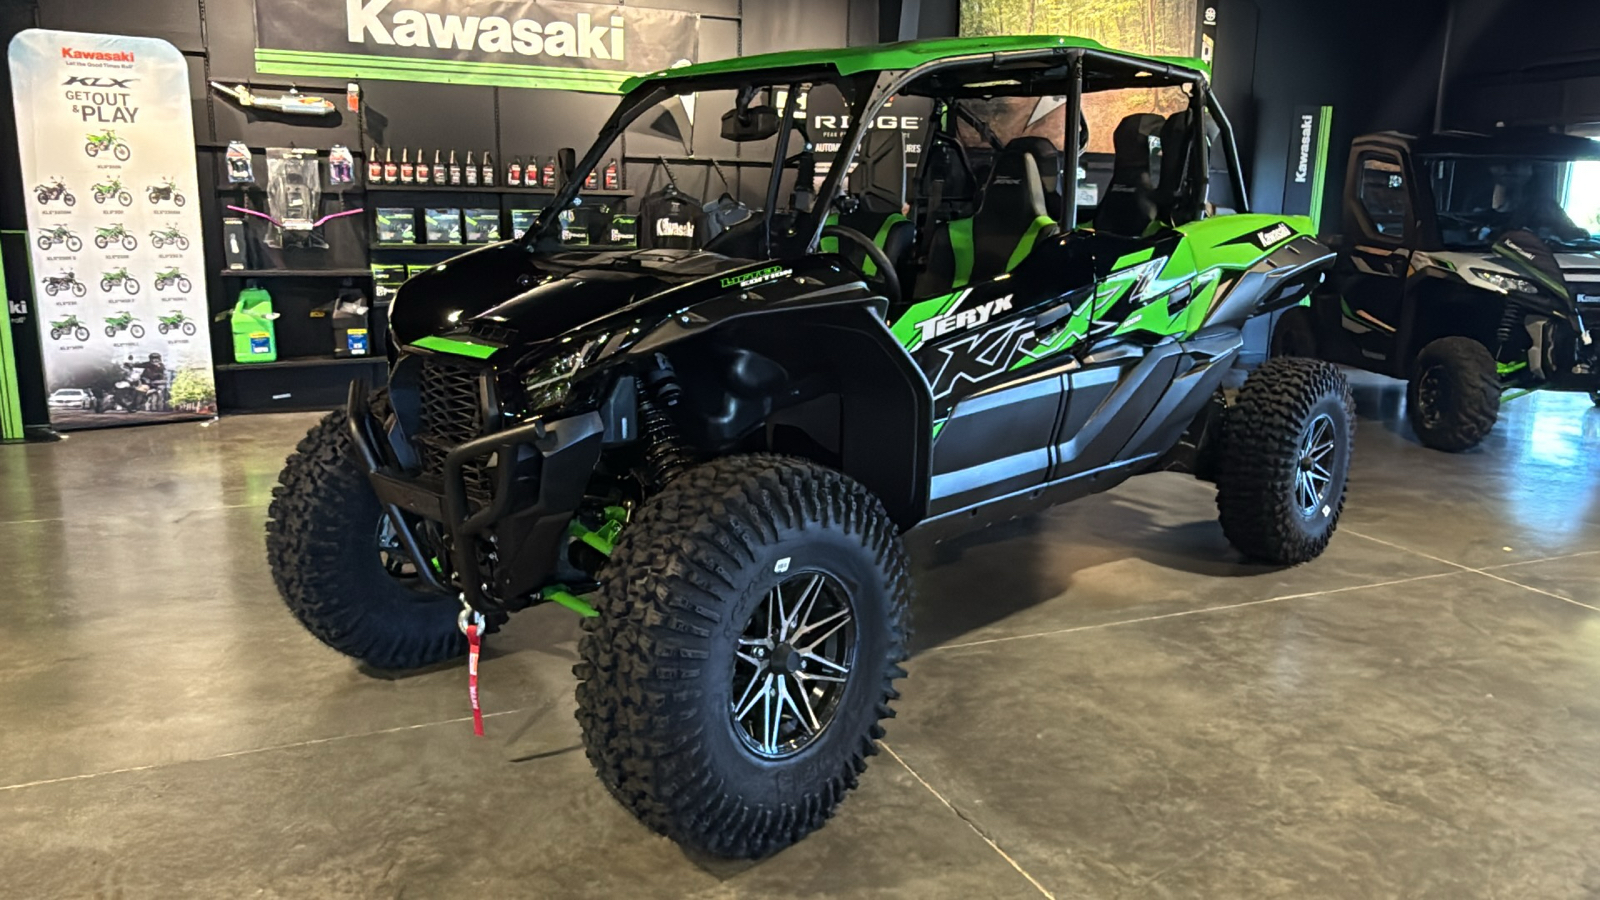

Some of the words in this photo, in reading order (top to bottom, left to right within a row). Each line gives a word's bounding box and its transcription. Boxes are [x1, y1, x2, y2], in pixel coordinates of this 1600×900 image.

[346, 0, 625, 61] Kawasaki
[61, 47, 135, 62] Kawasaki
[61, 75, 141, 89] KLX
[65, 90, 91, 101] GET
[92, 92, 131, 106] OUT
[72, 104, 80, 113] &
[81, 105, 139, 124] PLAY
[1295, 115, 1313, 183] Kawasaki
[912, 291, 1015, 343] TERYX
